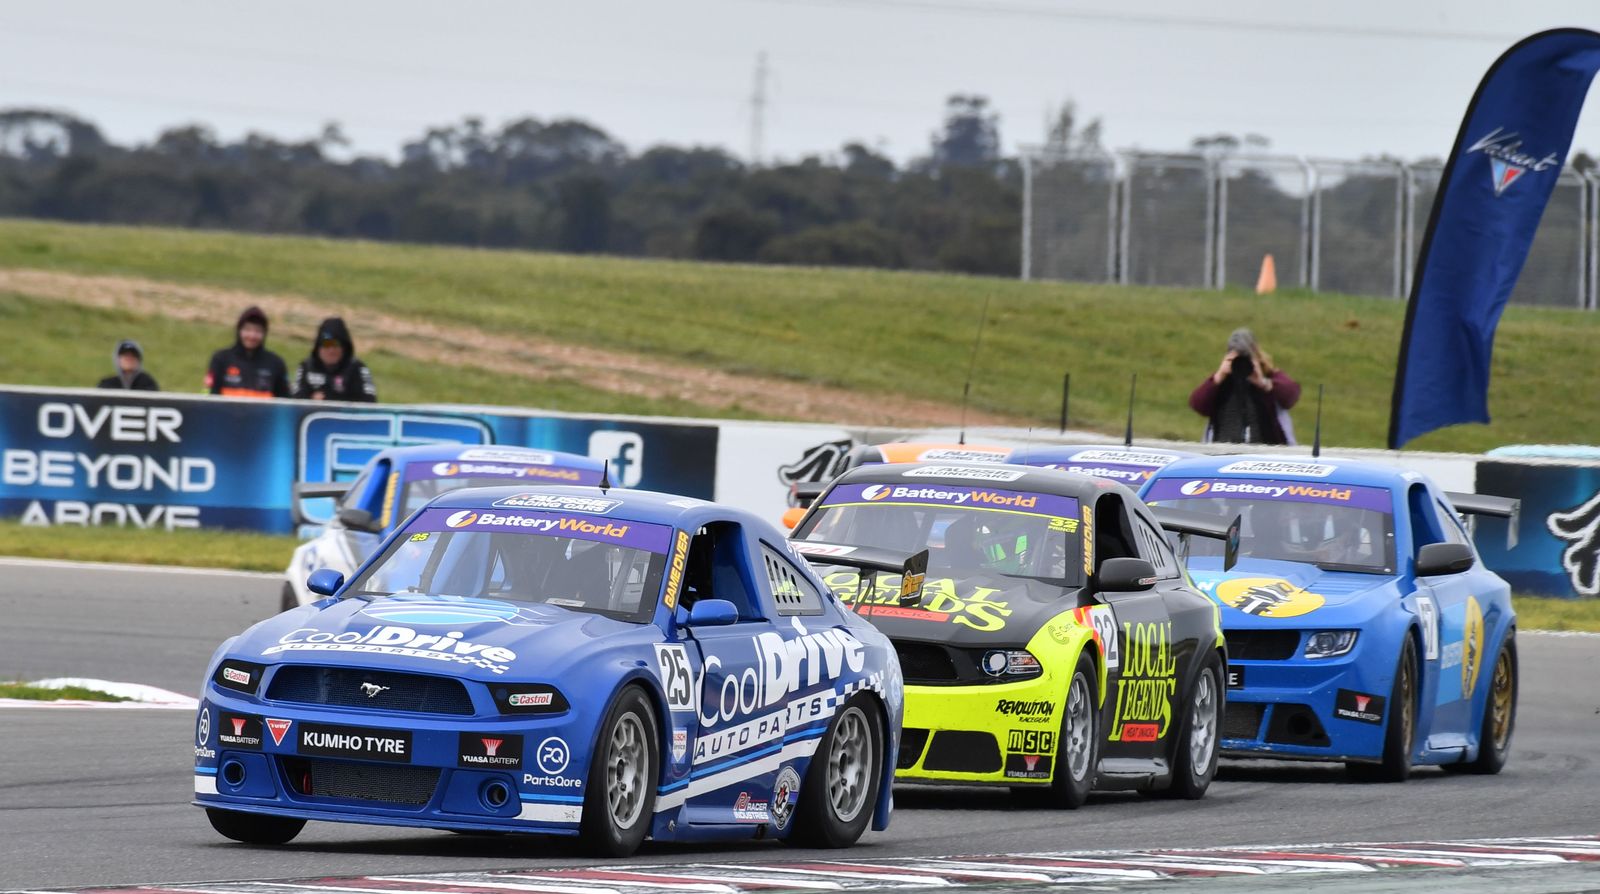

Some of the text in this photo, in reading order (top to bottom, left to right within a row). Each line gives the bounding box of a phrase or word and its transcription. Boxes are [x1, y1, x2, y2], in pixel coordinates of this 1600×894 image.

[1466, 126, 1558, 171] Valiant
[38, 403, 182, 442] OVER
[3, 450, 215, 492] BEYOND
[936, 466, 1011, 475] AUSSIE
[1252, 462, 1327, 470] AUSSIE
[914, 470, 1011, 480] RACING CARS
[503, 499, 606, 512] RACING CARS
[528, 495, 614, 507] AUSSIE
[1050, 519, 1078, 528] 32
[410, 533, 430, 542] 25
[278, 625, 517, 663] CoolDrive
[1094, 614, 1117, 660] 32
[277, 643, 441, 658] AUTO PARTS
[1122, 621, 1176, 677] LOCAL
[229, 669, 249, 682] Castrol
[660, 648, 690, 706] 25
[696, 616, 864, 727] CoolDrive
[520, 695, 549, 704] Castrol
[995, 699, 1056, 717] REVOLUTION
[1108, 678, 1176, 742] LEGENDS
[694, 698, 822, 760] AUTO PARTS
[220, 735, 259, 745] YUASA BATTERY
[303, 731, 405, 754] KUMHO TYRE
[463, 755, 519, 765] YUASA BATTERY
[523, 774, 581, 788] PartsQore
[747, 803, 768, 811] RACER
